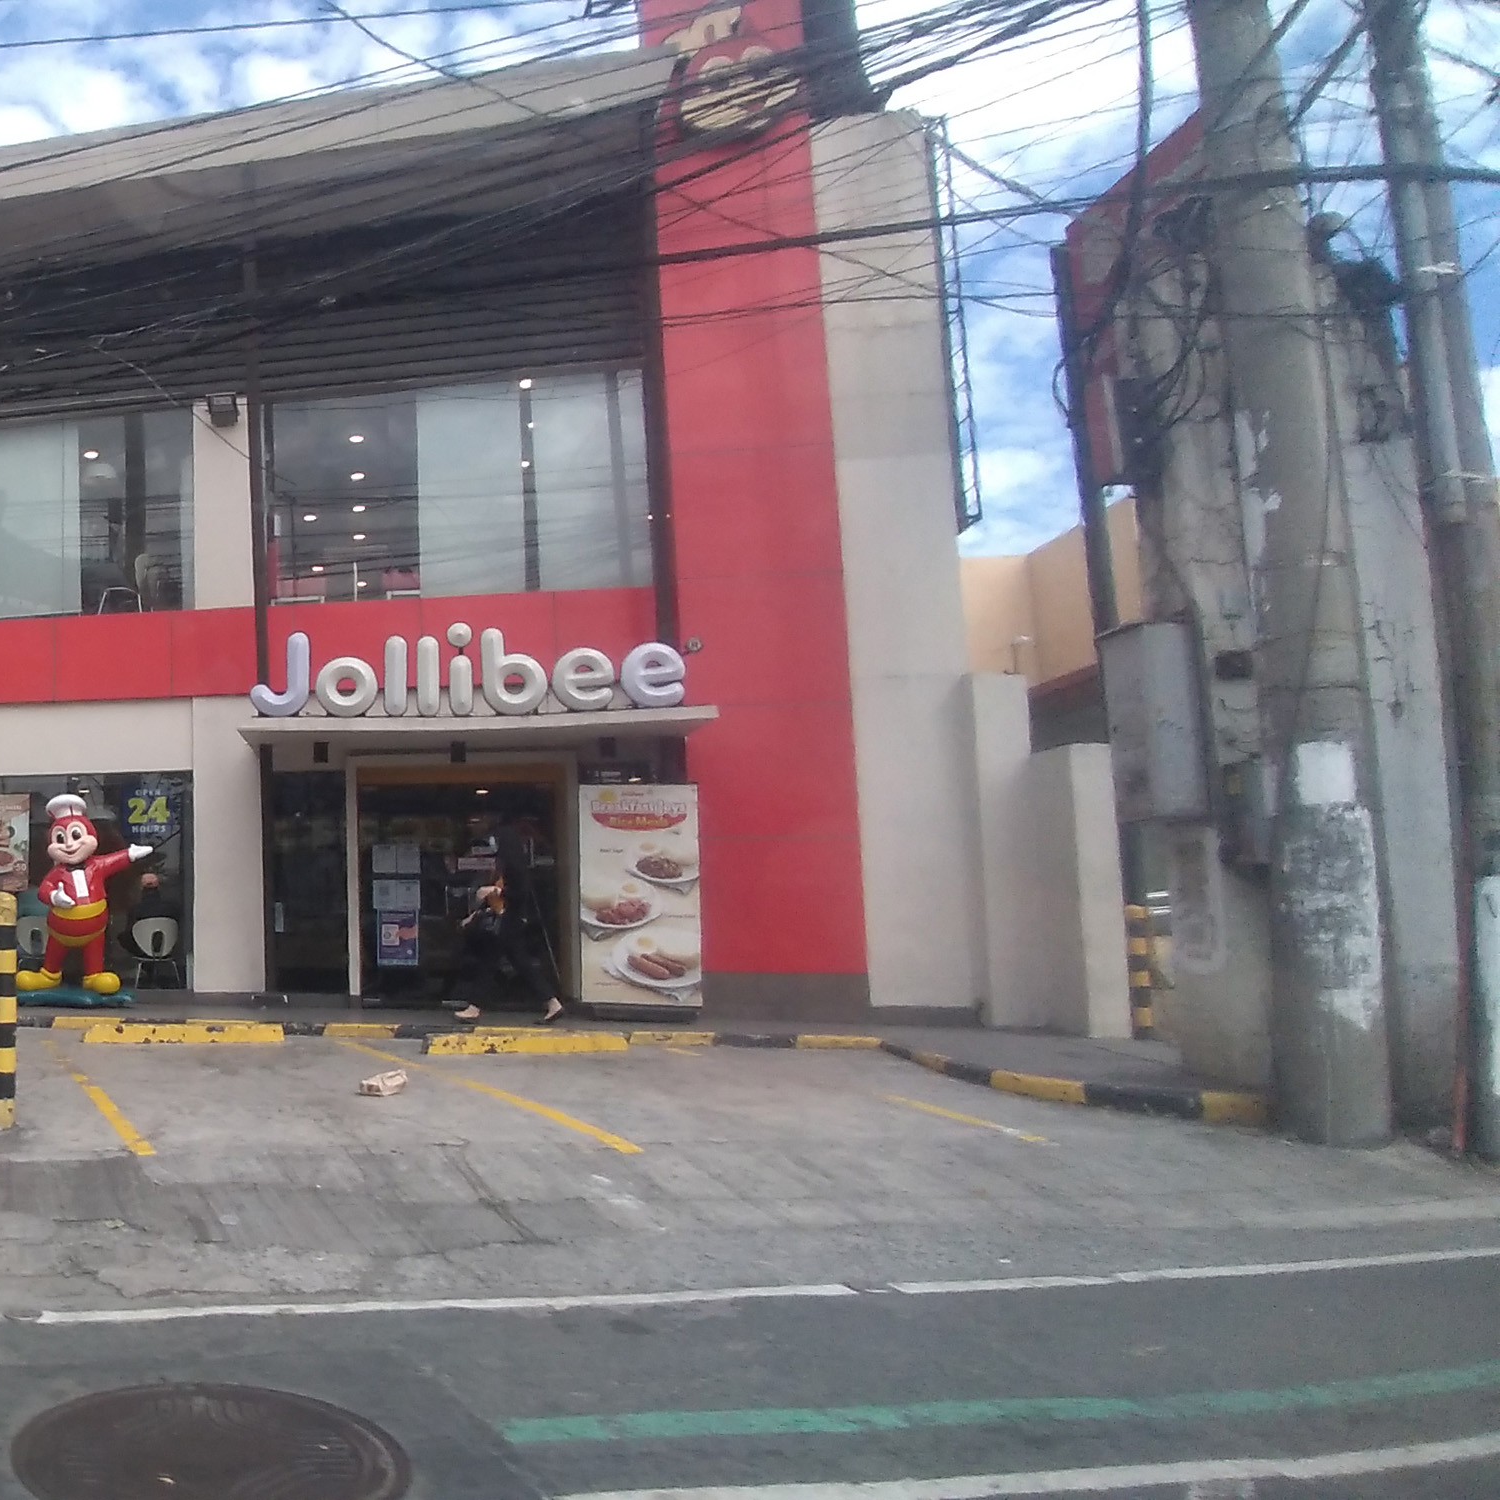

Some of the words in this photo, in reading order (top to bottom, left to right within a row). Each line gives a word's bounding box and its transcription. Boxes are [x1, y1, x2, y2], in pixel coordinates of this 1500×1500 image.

[250, 622, 687, 718] Jollibee
[127, 796, 170, 824] 24
[131, 825, 167, 833] HOURS
